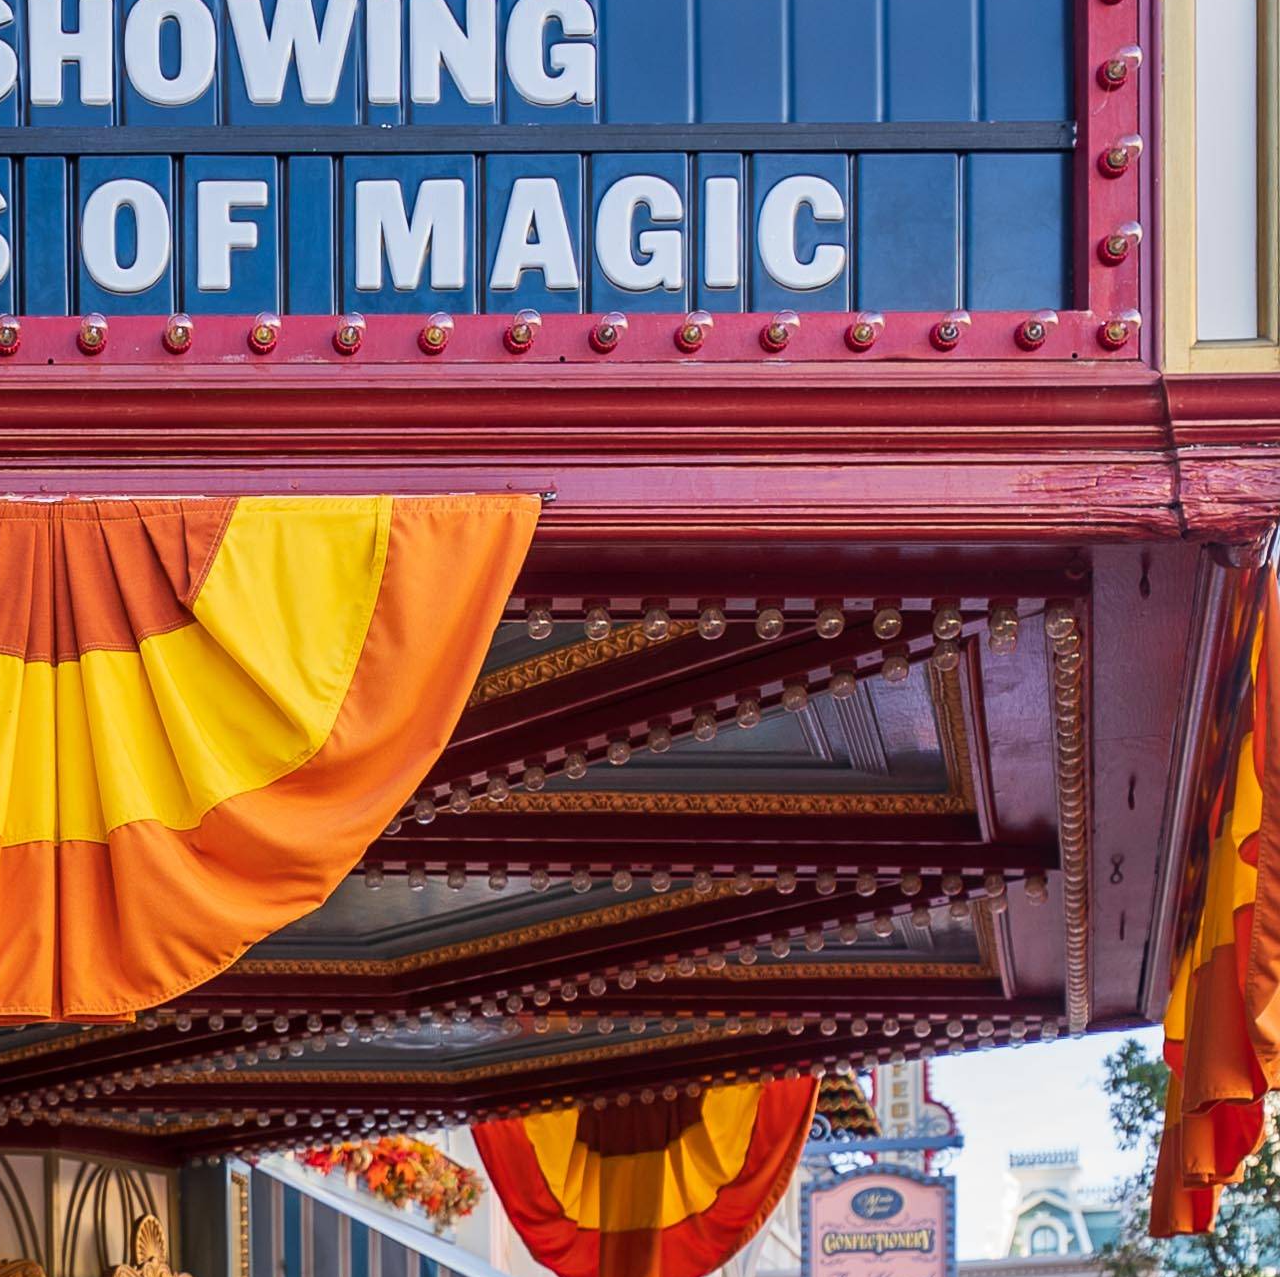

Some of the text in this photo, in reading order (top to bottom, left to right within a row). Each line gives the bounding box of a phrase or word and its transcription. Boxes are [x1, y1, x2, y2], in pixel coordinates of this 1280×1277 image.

[80, 177, 270, 294] OF
[353, 174, 847, 292] MAGIC
[823, 1229, 933, 1254] CONFECTIONERY
